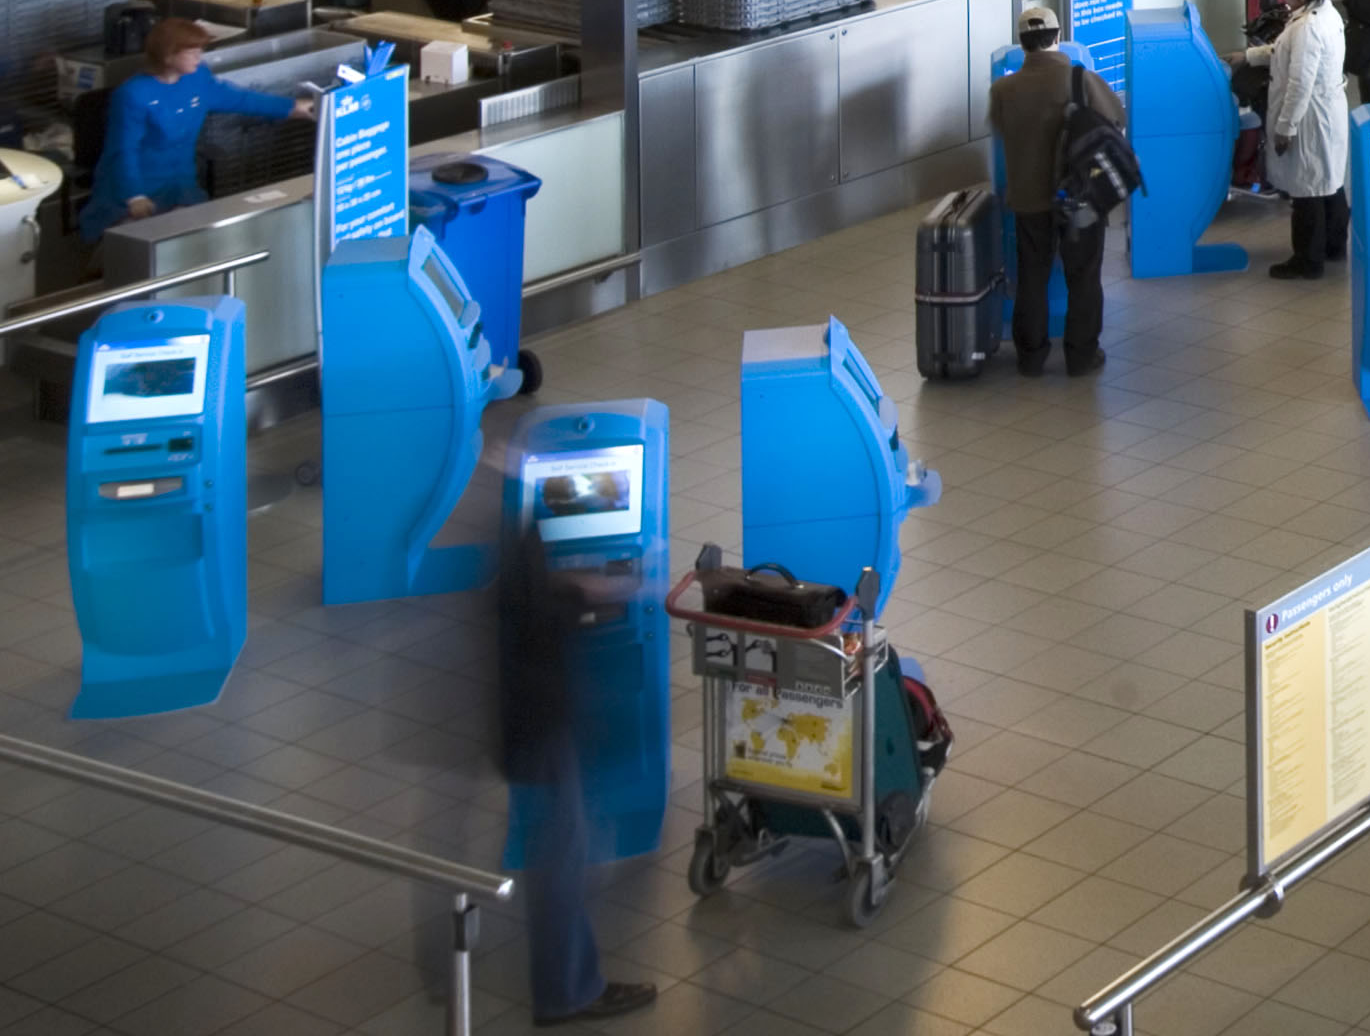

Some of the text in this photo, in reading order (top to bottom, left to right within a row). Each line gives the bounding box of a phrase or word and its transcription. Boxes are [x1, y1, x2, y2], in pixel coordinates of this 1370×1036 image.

[1282, 572, 1353, 622] Passengers only
[773, 686, 843, 709] assengers
